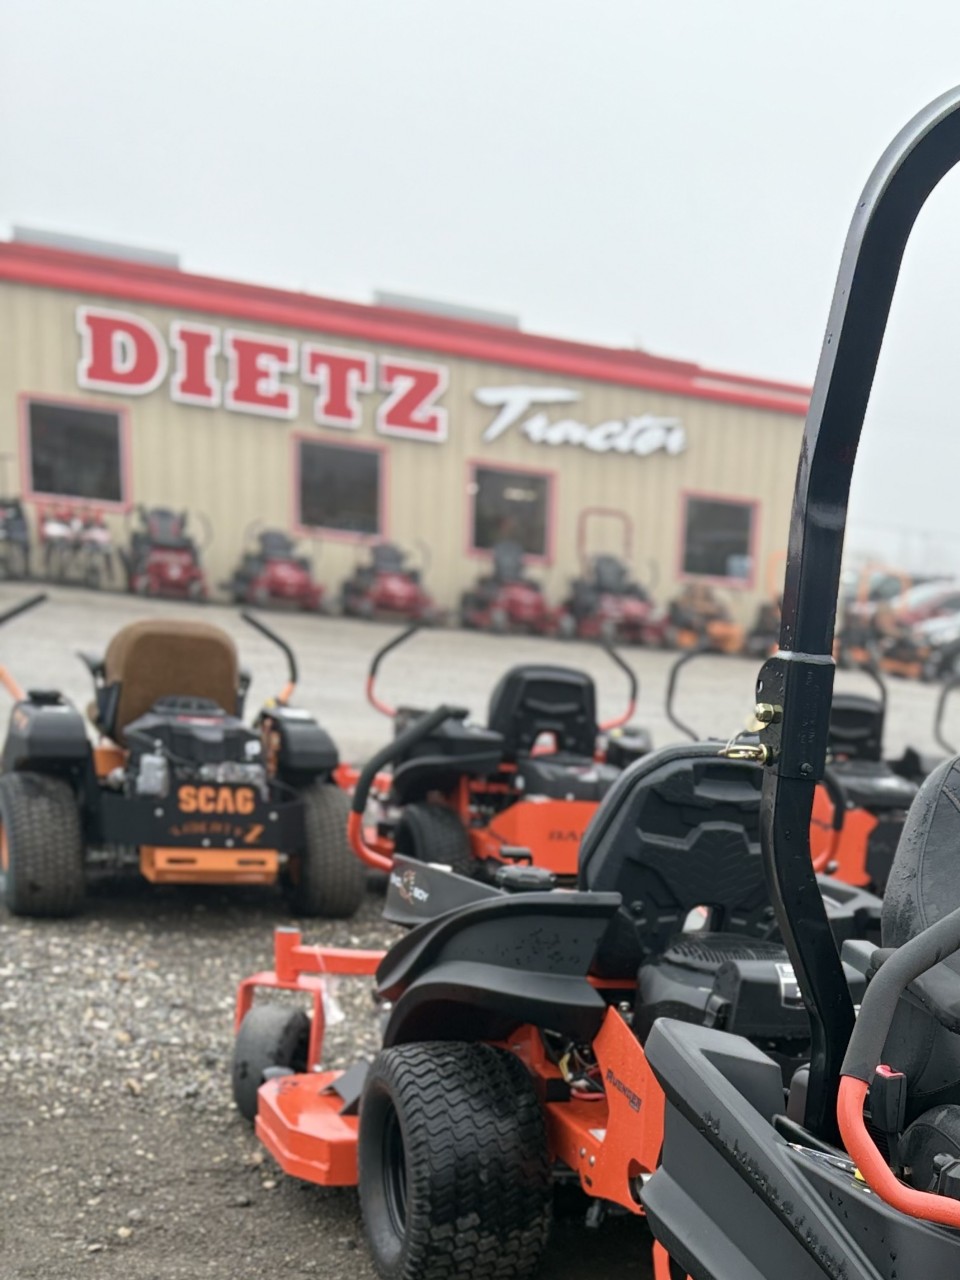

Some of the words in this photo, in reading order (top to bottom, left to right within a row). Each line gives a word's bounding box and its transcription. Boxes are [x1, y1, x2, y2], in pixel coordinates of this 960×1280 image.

[76, 305, 448, 443] DIETZ
[474, 385, 686, 455] Tractor
[178, 784, 256, 815] SCAG
